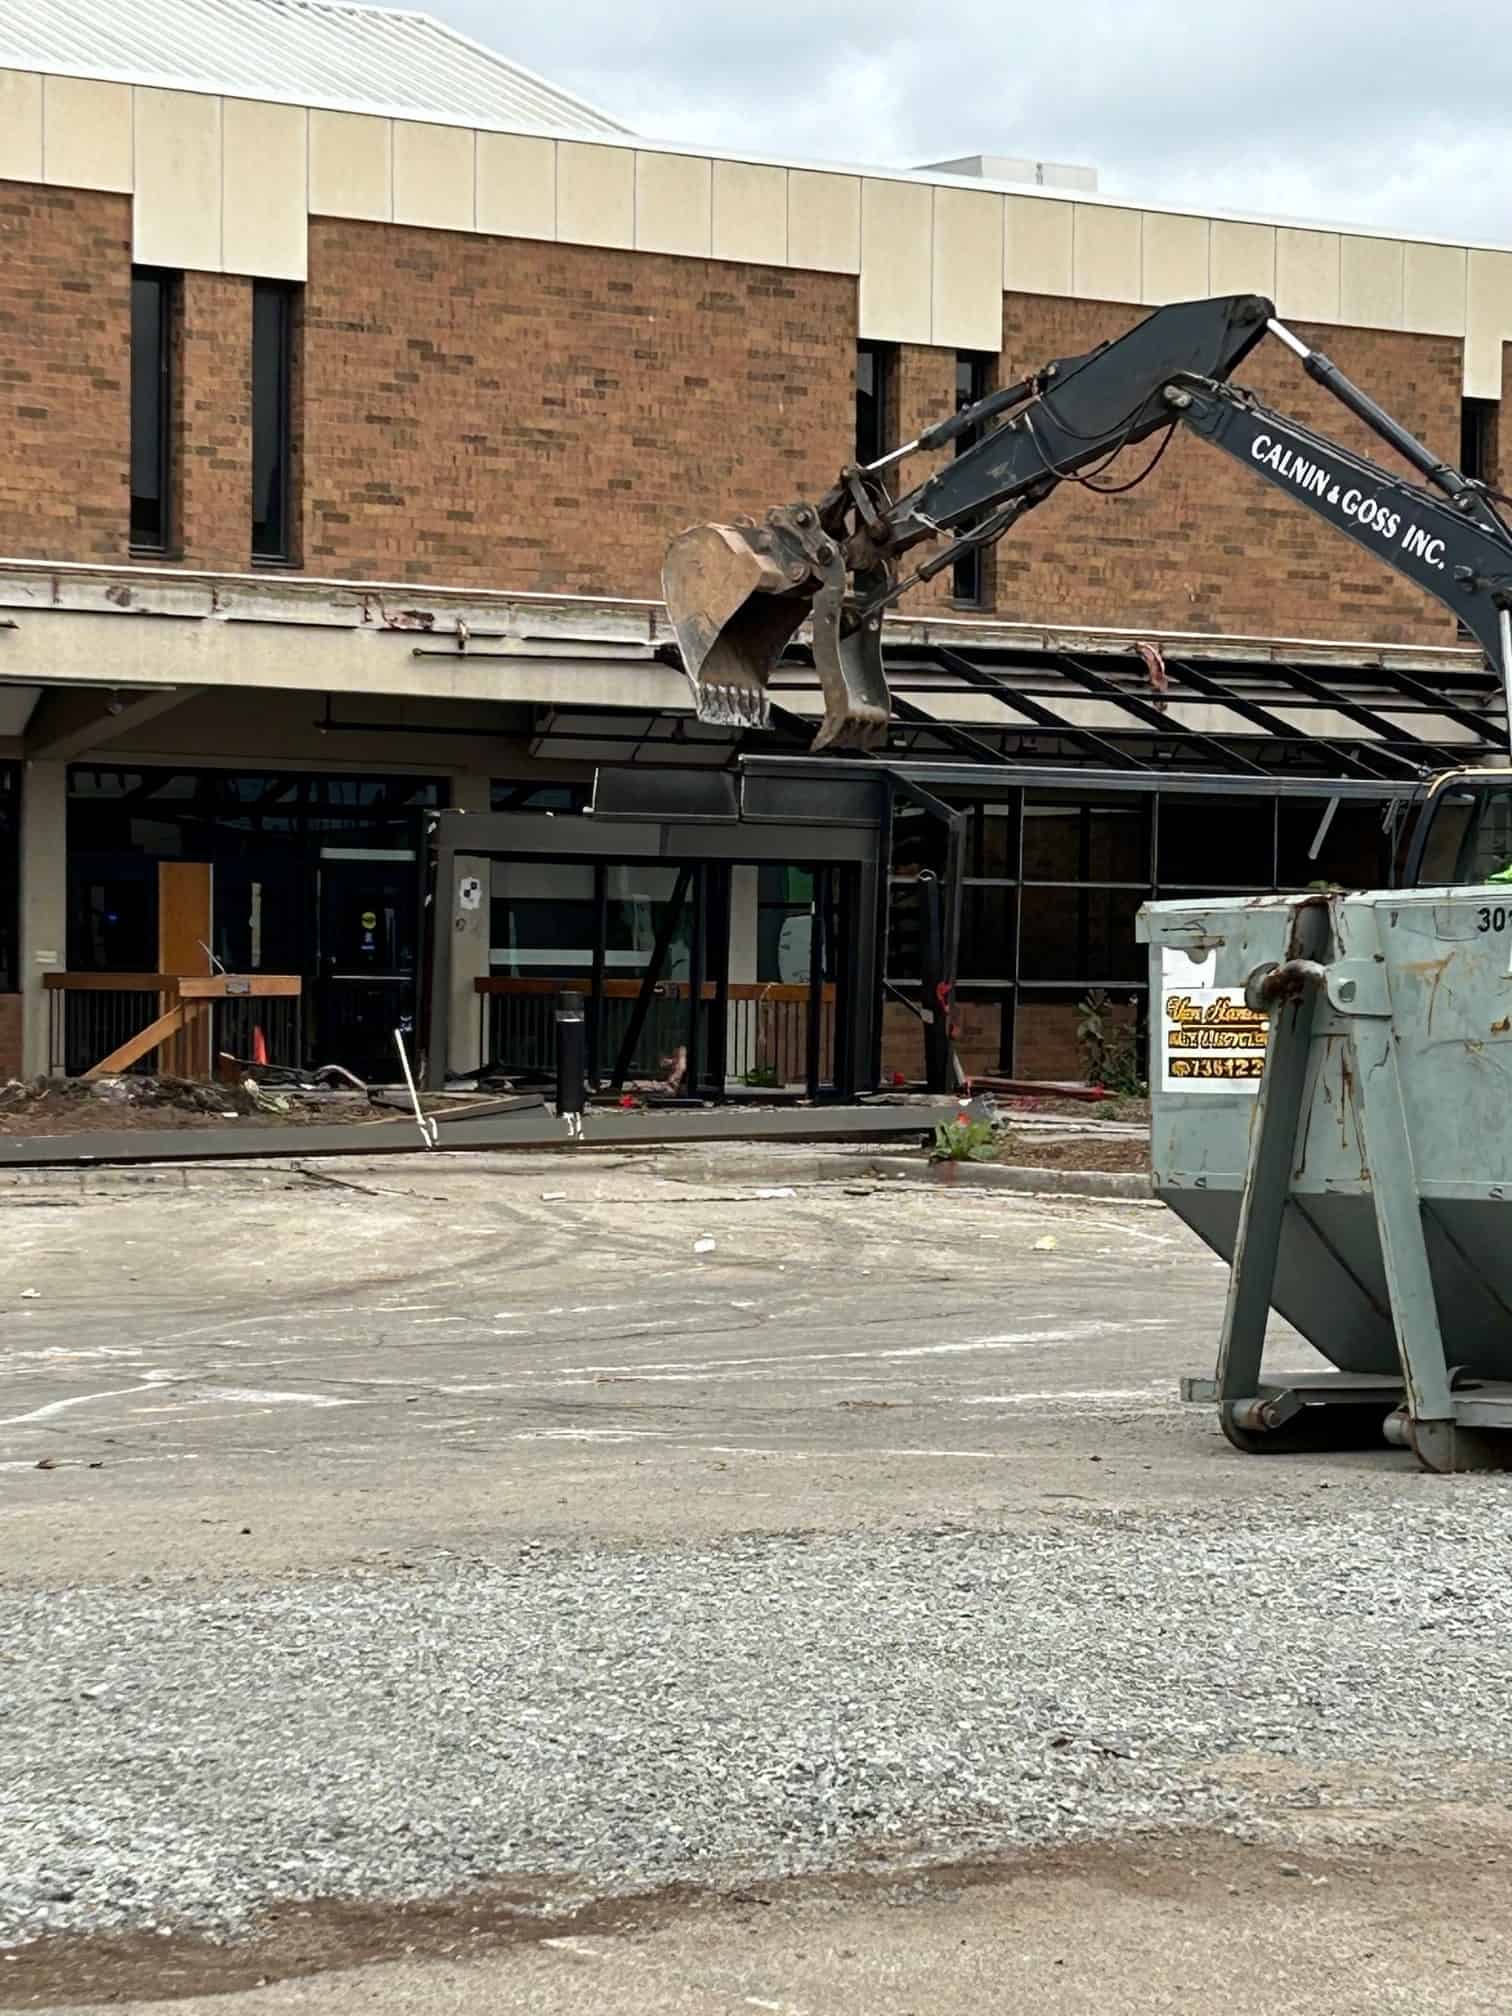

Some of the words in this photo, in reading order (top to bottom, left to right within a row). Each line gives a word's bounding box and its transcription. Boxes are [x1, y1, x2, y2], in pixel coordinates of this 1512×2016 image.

[1251, 434, 1330, 496] CALNIN
[1327, 486, 1342, 504] &
[1342, 489, 1401, 538] GOSS
[1401, 524, 1446, 570] INC.
